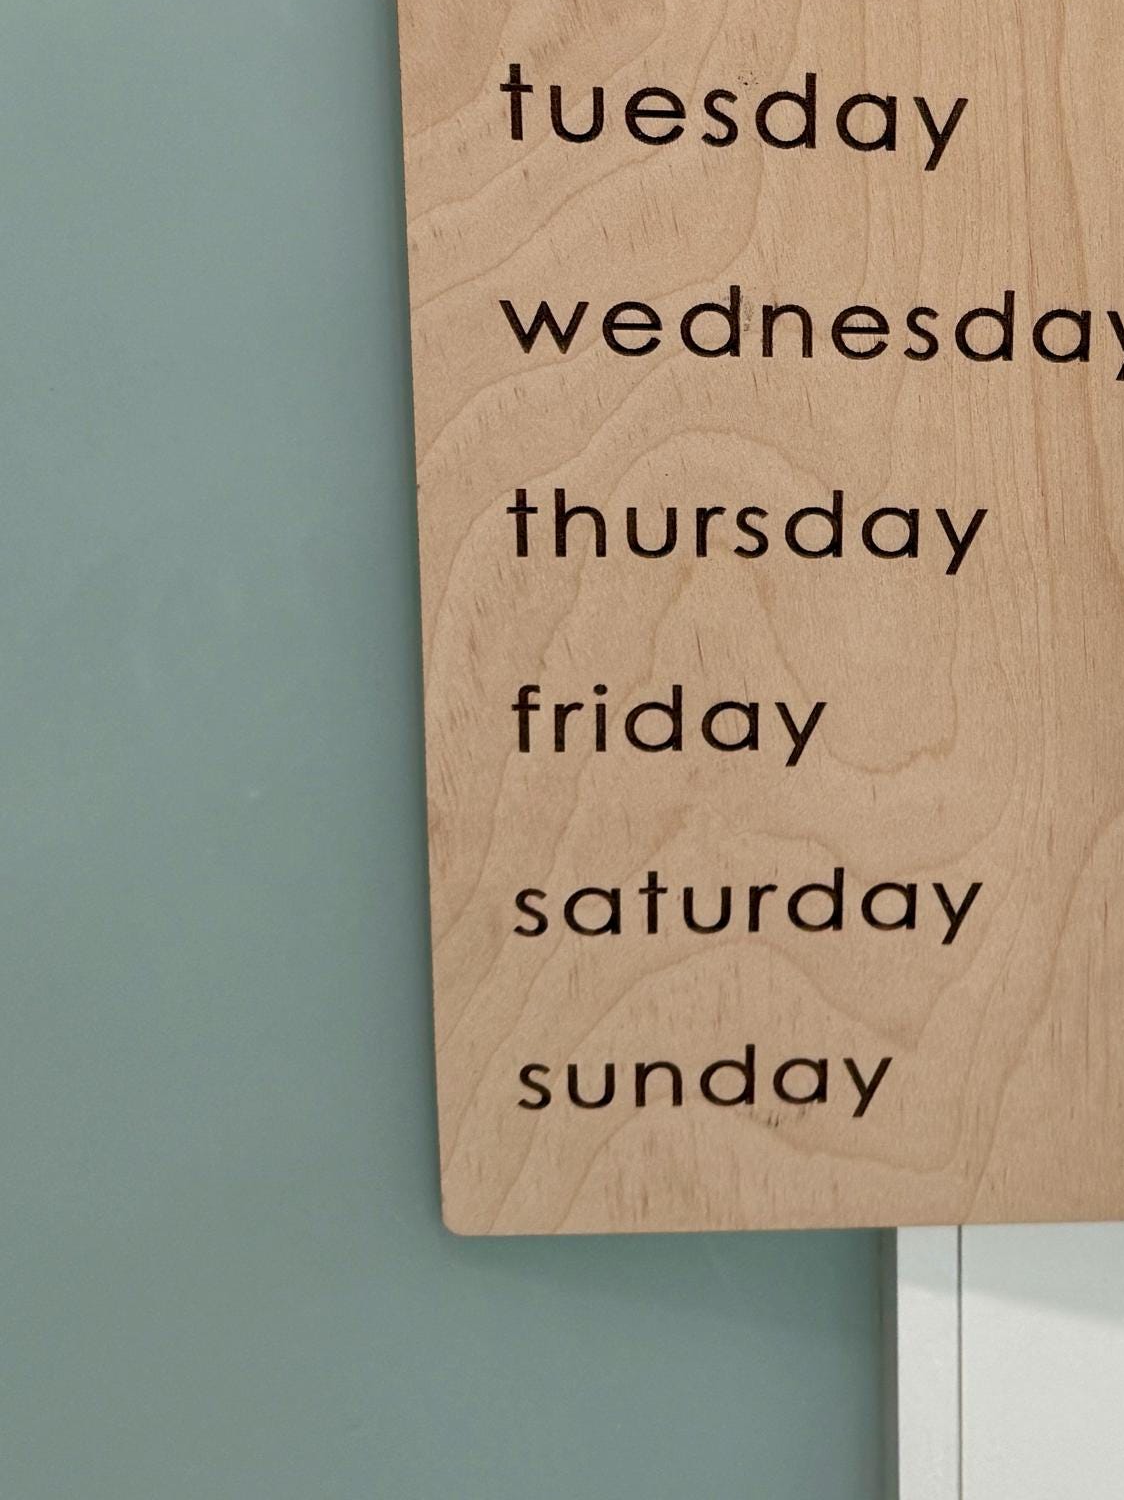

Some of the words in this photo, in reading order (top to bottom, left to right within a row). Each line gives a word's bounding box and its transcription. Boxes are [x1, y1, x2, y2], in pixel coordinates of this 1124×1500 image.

[500, 64, 968, 170] tuesday
[507, 488, 988, 576] thursday
[512, 683, 827, 767] friday
[513, 866, 983, 945] saturday
[518, 1043, 893, 1118] sunday
